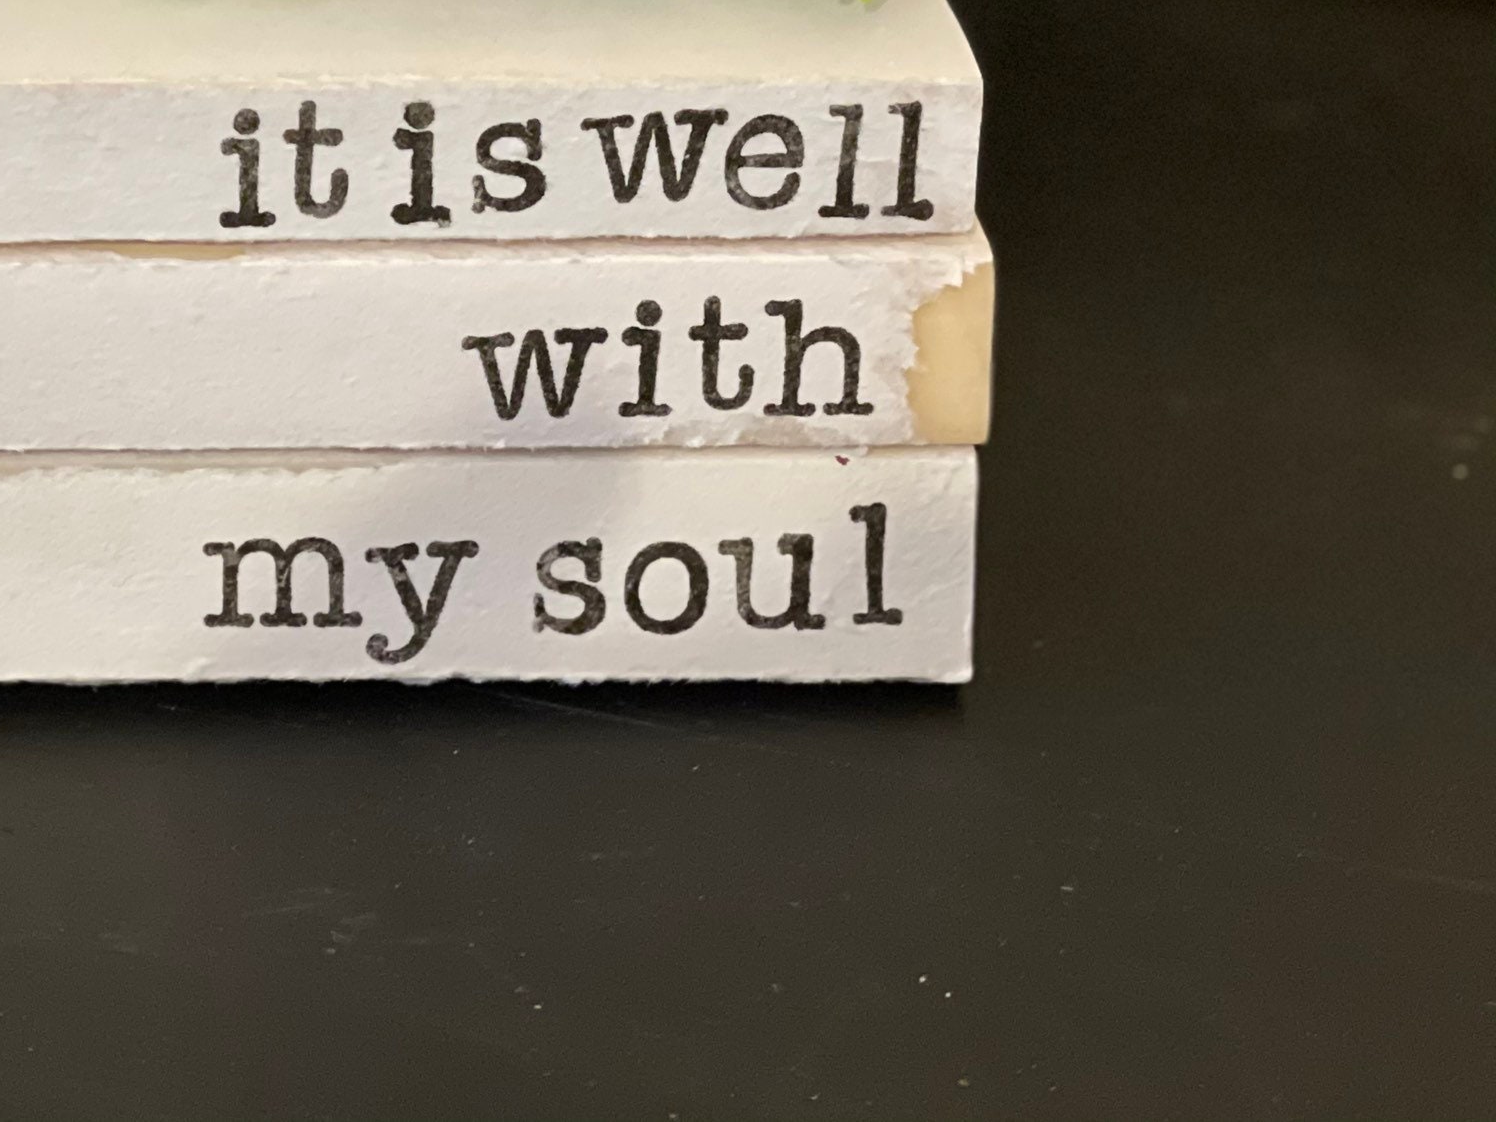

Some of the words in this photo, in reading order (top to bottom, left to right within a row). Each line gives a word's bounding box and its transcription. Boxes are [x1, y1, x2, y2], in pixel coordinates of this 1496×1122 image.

[218, 99, 350, 229] it
[390, 101, 548, 227] is
[579, 100, 935, 222] well
[461, 294, 875, 421] with
[202, 535, 481, 666] my
[533, 502, 904, 636] soul
